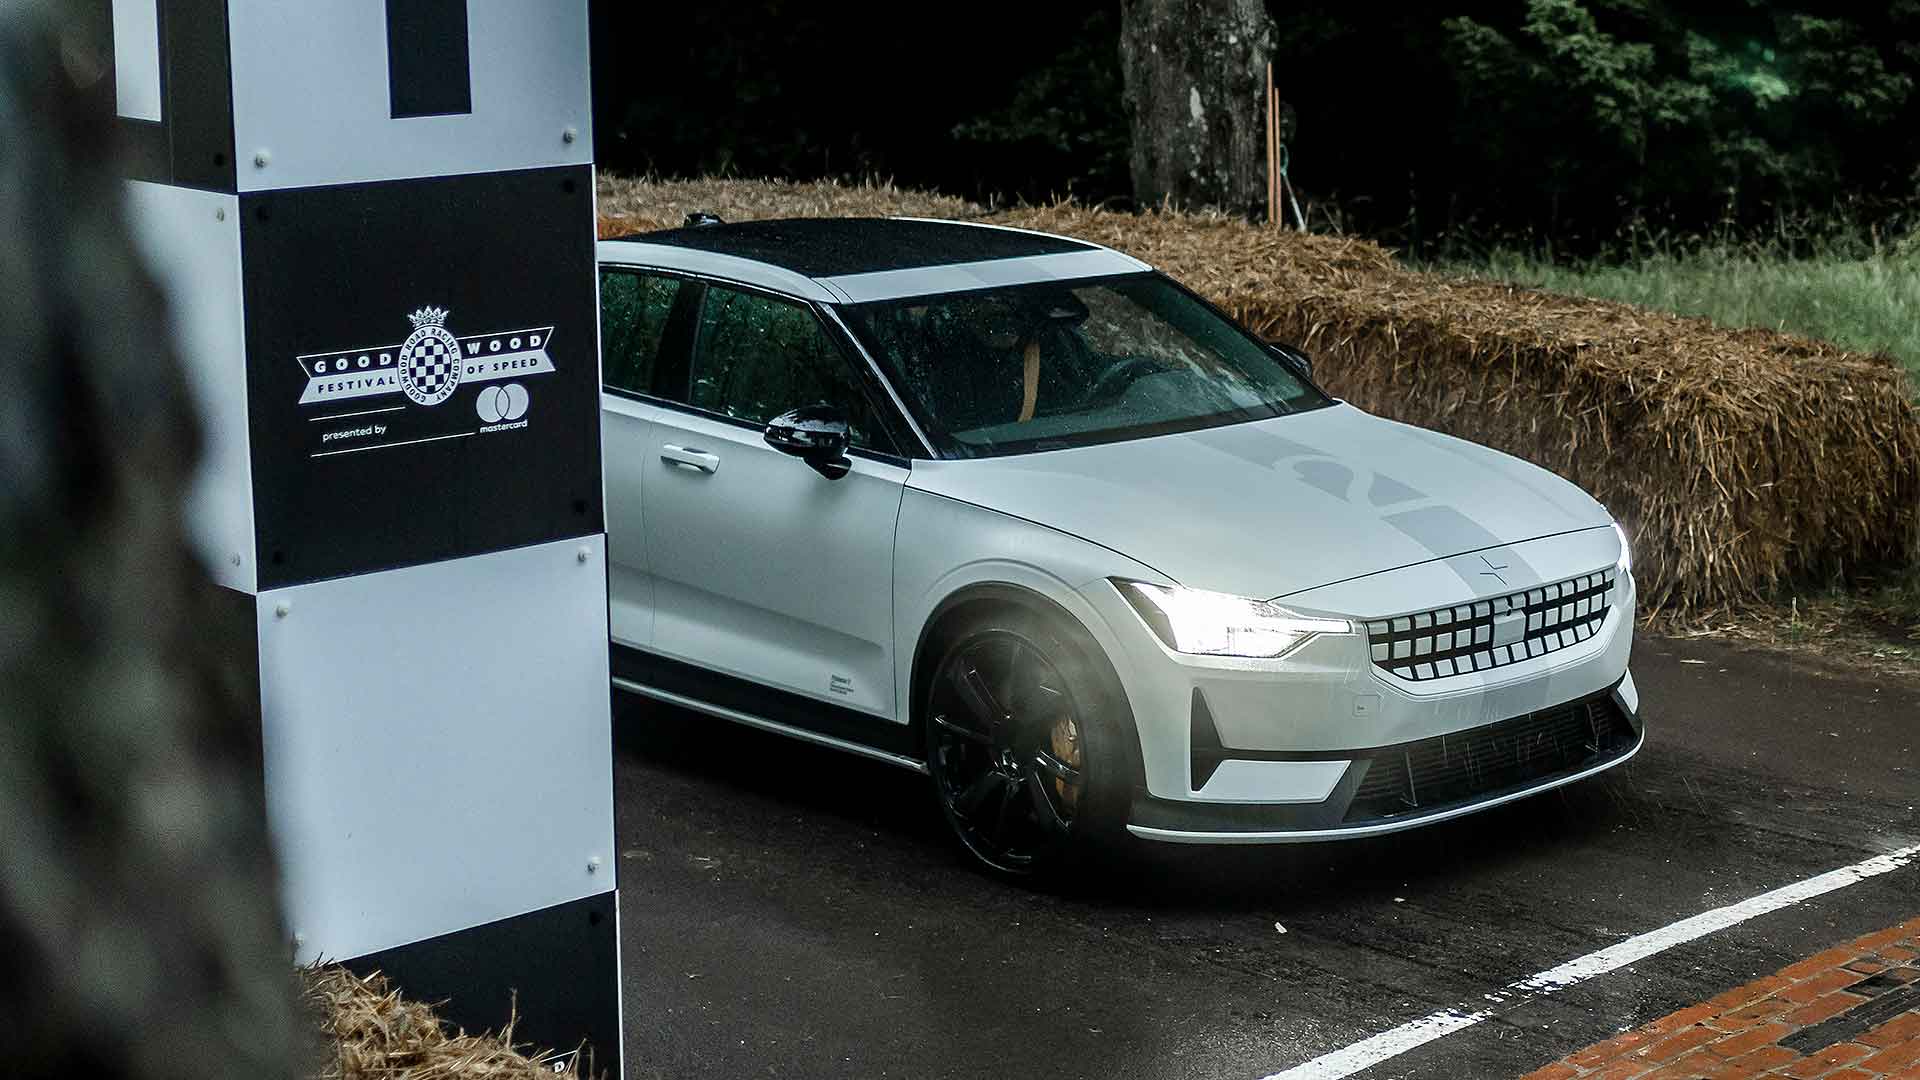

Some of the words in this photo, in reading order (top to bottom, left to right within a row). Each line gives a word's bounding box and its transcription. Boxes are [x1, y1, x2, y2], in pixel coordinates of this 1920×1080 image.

[318, 375, 396, 394] FESTIVAL
[467, 364, 485, 375] OF
[493, 358, 538, 372] SPEED
[322, 426, 372, 443] presented
[374, 424, 387, 436] by
[479, 419, 528, 434] mastercard
